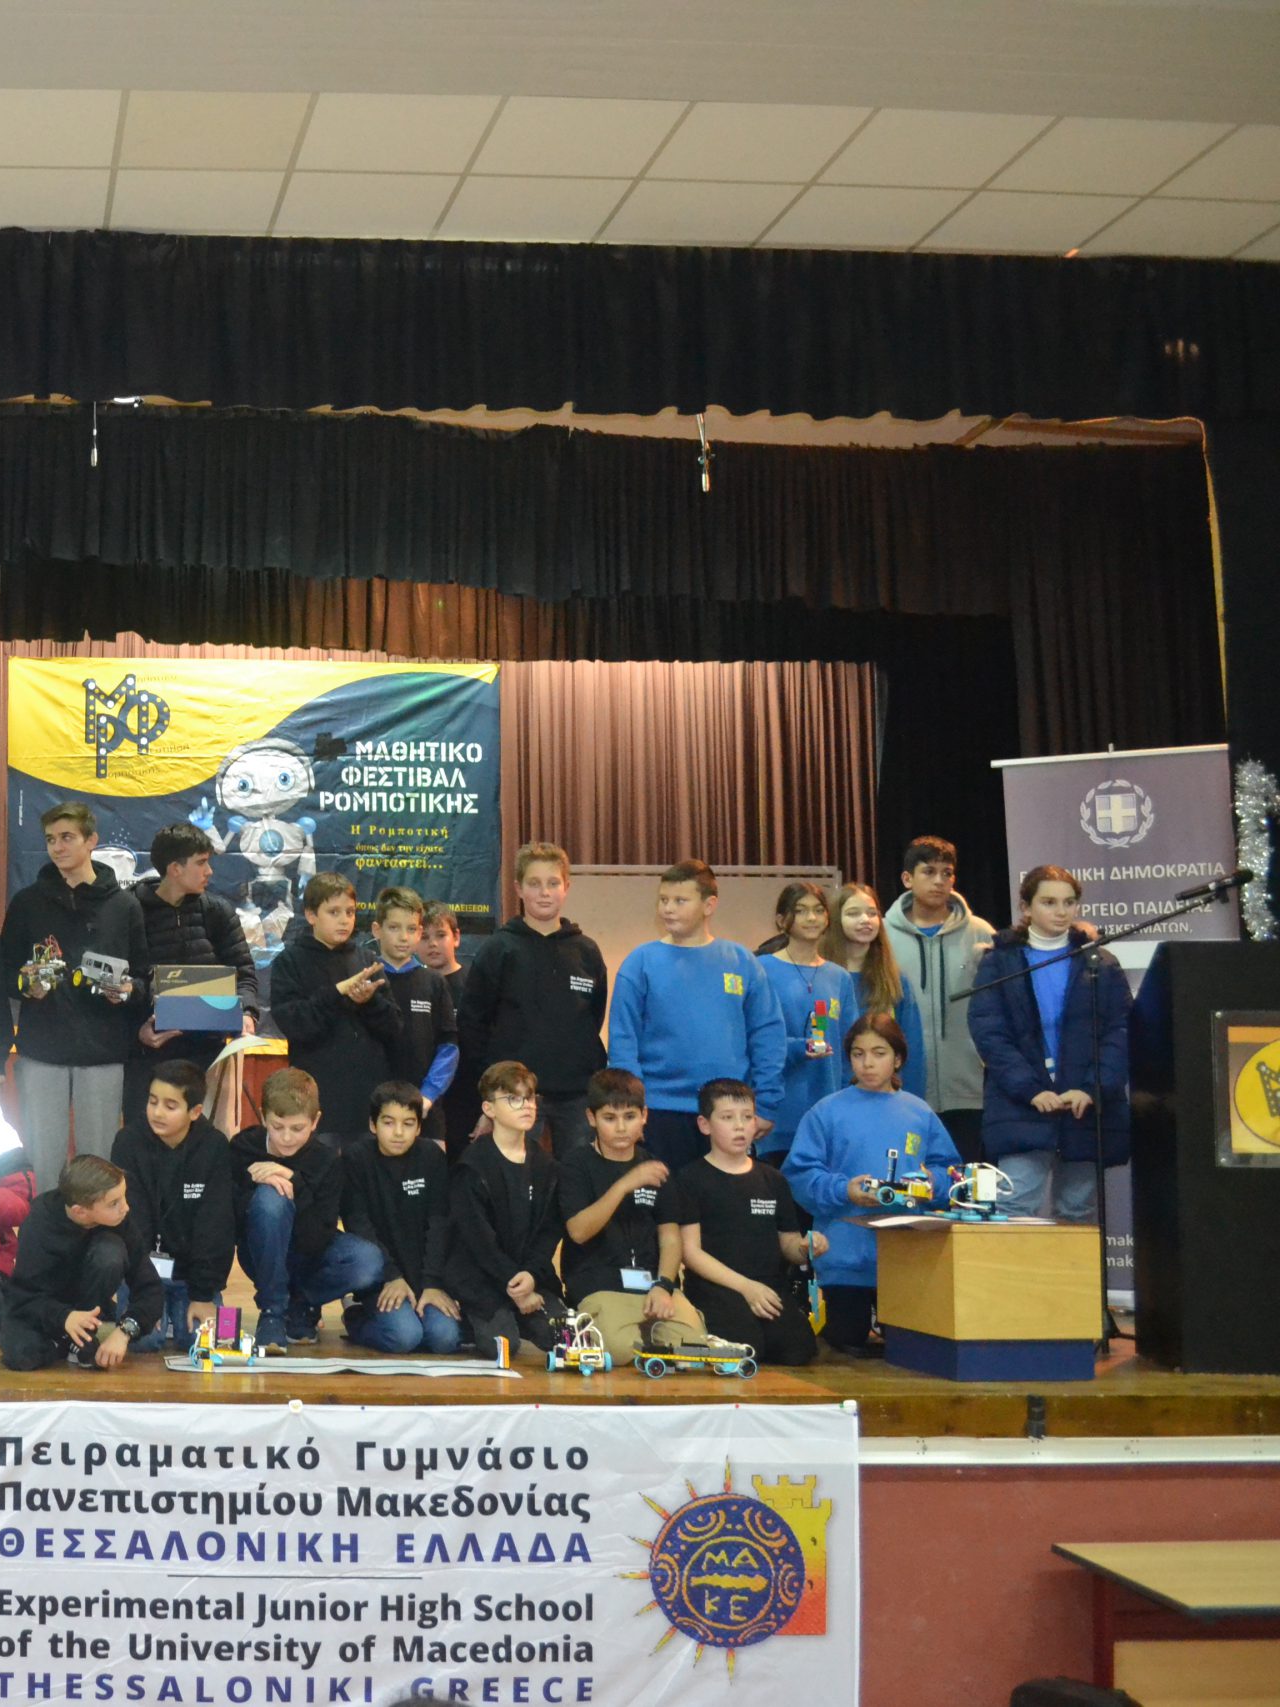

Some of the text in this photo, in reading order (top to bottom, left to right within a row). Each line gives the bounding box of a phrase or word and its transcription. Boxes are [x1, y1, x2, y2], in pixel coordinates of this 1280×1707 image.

[355, 740, 483, 763] ΜΑΘΗΤΙΚΟ
[341, 766, 467, 788] ΦΕΣΤΙΒΑΛ
[319, 791, 479, 814] ΡΟΜΠΟΤΙΚΗΣ
[369, 825, 449, 839] Ρομποτική
[1109, 862, 1226, 880] ΔΗΜΟΚΡΑΤΙΑ
[356, 1437, 589, 1480] Γυμνάσιο
[337, 1484, 591, 1524] Μακεδονίας
[396, 1533, 592, 1563] ΕΛΛΑΔΑ
[252, 1592, 369, 1628] Junior
[380, 1592, 461, 1629] High
[474, 1593, 593, 1622] School
[48, 1630, 110, 1659] the
[129, 1632, 322, 1671] University
[338, 1634, 377, 1663] of
[393, 1634, 593, 1663] Macedonia
[410, 1676, 593, 1703] GREECE
